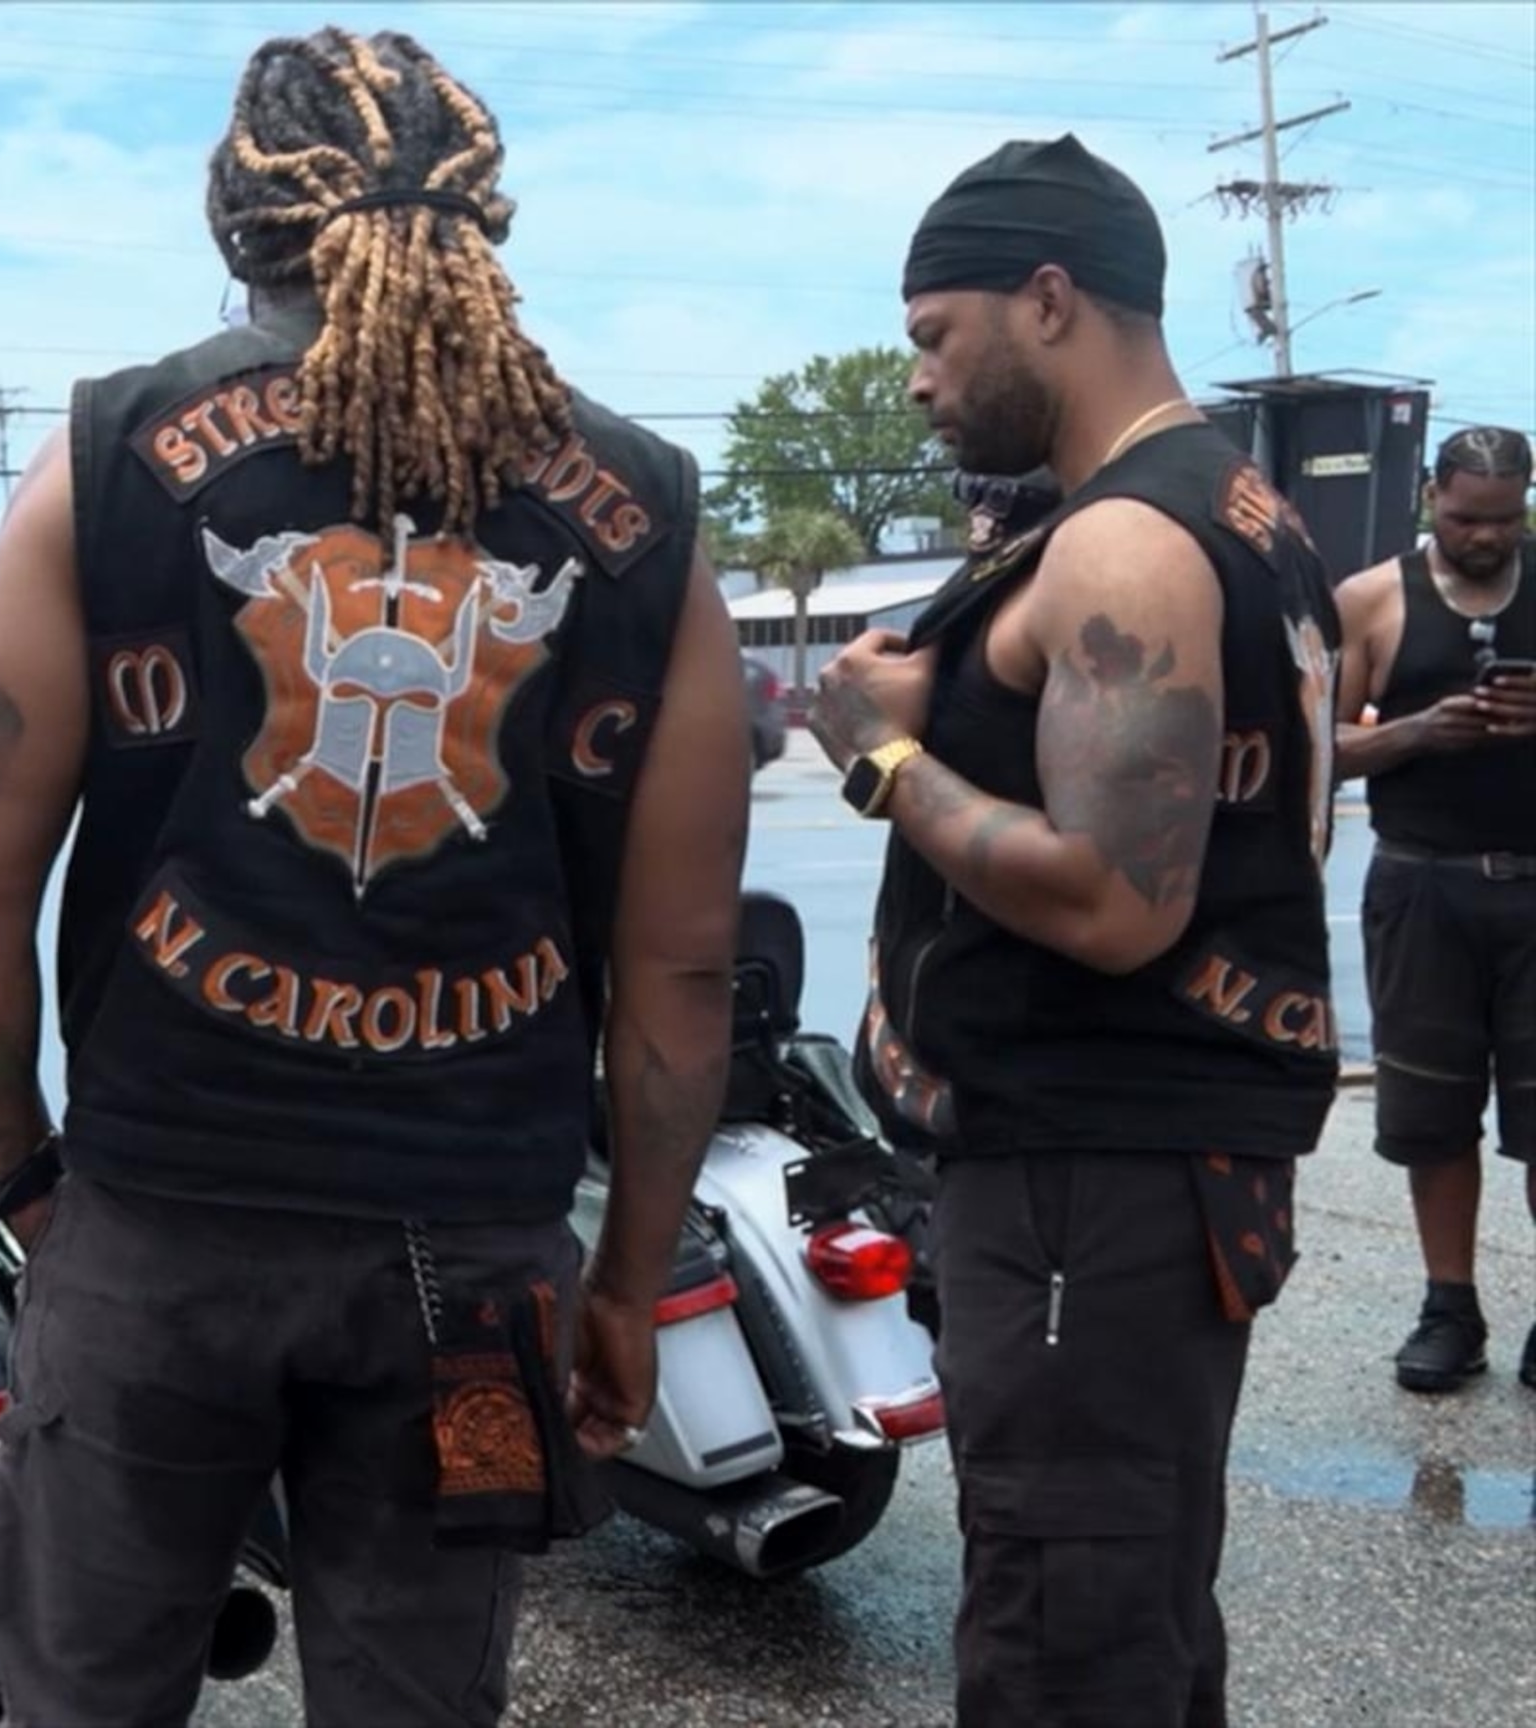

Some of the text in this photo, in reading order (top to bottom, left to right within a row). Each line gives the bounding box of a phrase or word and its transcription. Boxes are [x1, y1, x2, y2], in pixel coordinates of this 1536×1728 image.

[107, 644, 638, 777] M C
[134, 891, 569, 1053] N. CAROLINA
[1185, 953, 1258, 1024] N.
